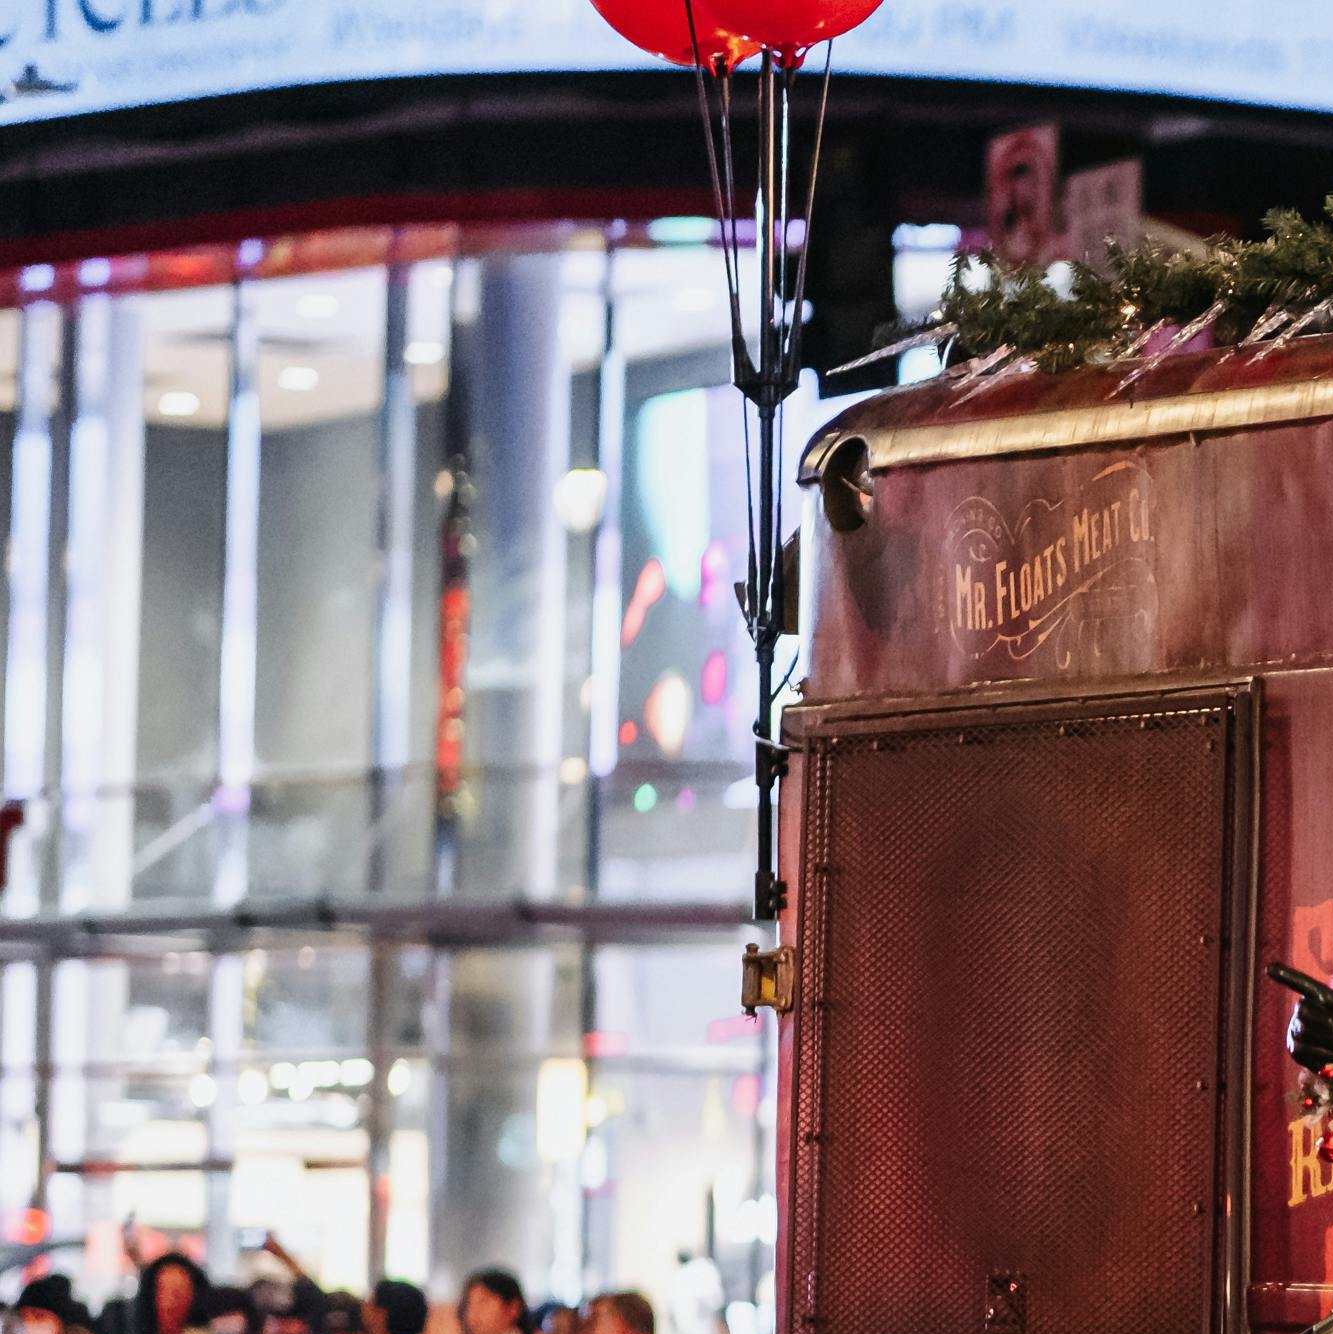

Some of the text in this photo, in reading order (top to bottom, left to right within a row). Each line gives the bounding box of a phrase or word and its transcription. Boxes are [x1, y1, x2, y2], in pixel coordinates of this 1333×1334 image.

[956, 563, 993, 630] MR.
[995, 536, 1067, 626] FLOATS
[1073, 501, 1121, 573] MEAT
